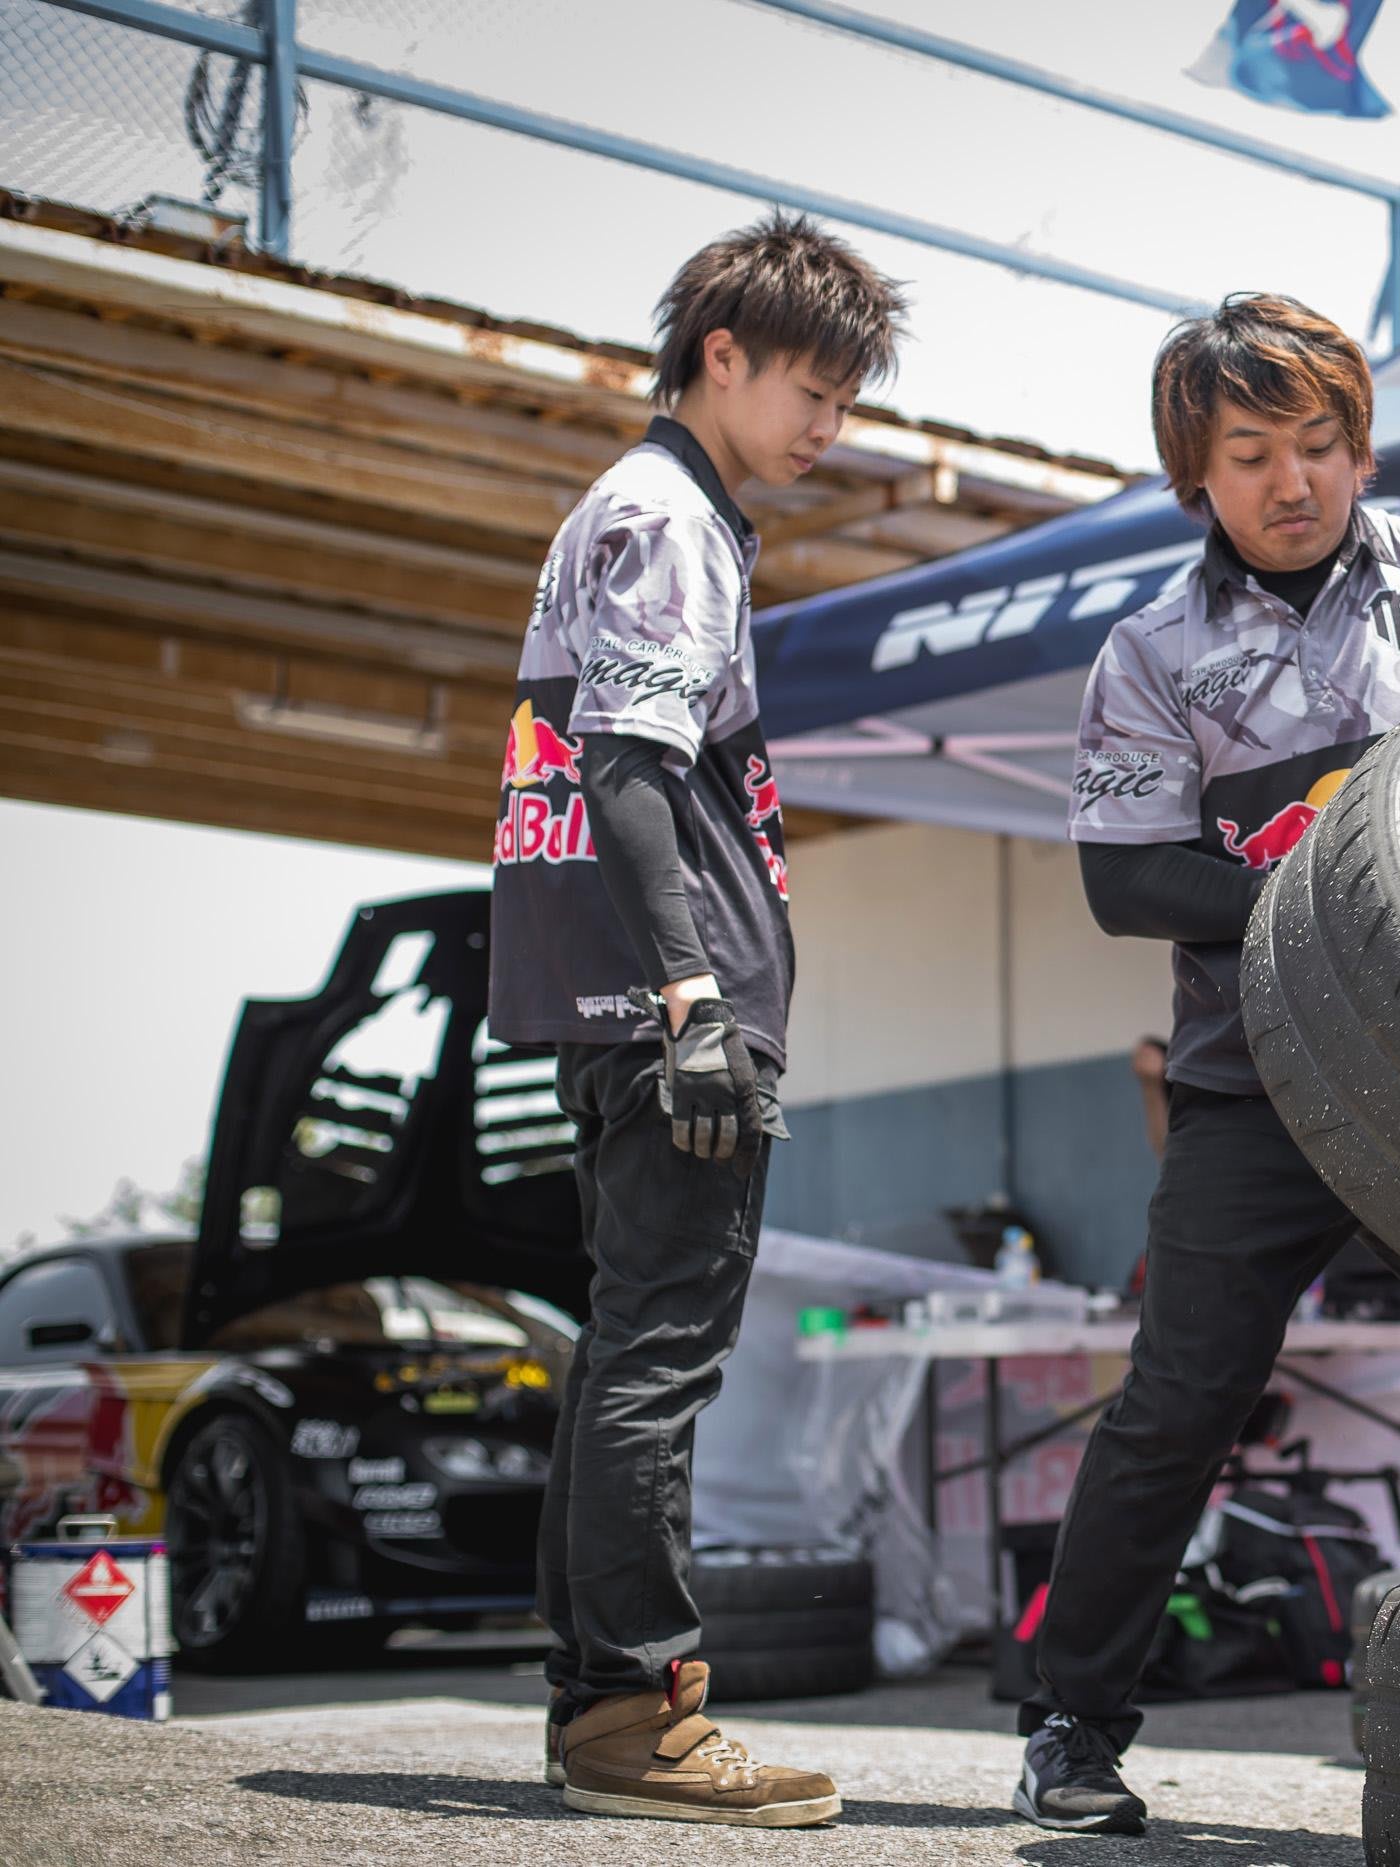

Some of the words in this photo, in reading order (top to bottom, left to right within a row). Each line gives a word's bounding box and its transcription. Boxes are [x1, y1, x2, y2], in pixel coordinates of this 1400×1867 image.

[628, 641, 657, 653] CAR
[1095, 751, 1161, 763] PRODUCE
[1073, 764, 1164, 812] agic
